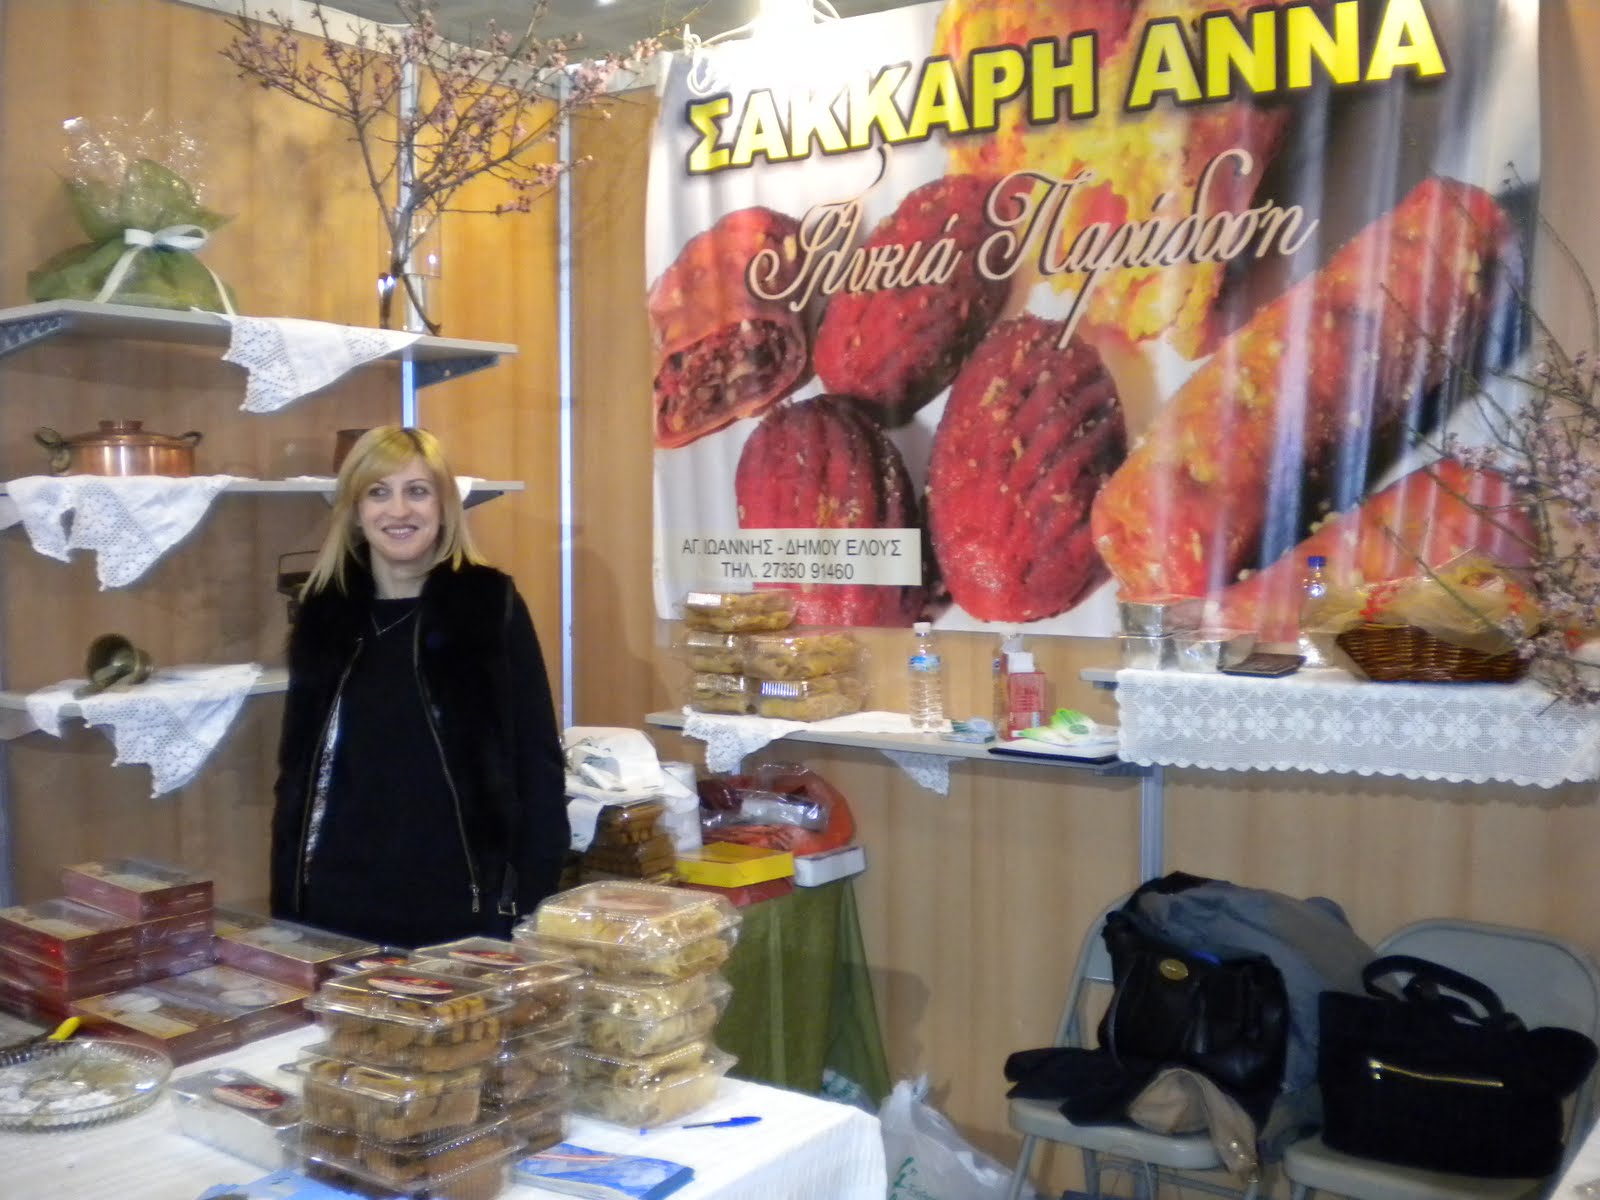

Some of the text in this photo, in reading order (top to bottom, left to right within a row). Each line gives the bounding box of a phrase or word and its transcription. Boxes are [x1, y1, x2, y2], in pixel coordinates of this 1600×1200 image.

[688, 0, 1447, 173] ΣΑΚΚΑΡΗ ΑΝΝΑ
[977, 148, 1320, 351] Παράδοση
[721, 561, 855, 580] ΤΗΛ. 27350 91460
[785, 538, 841, 556] ΔΗΜΟΥ
[846, 539, 902, 557] ΕΛΟΥΣ
